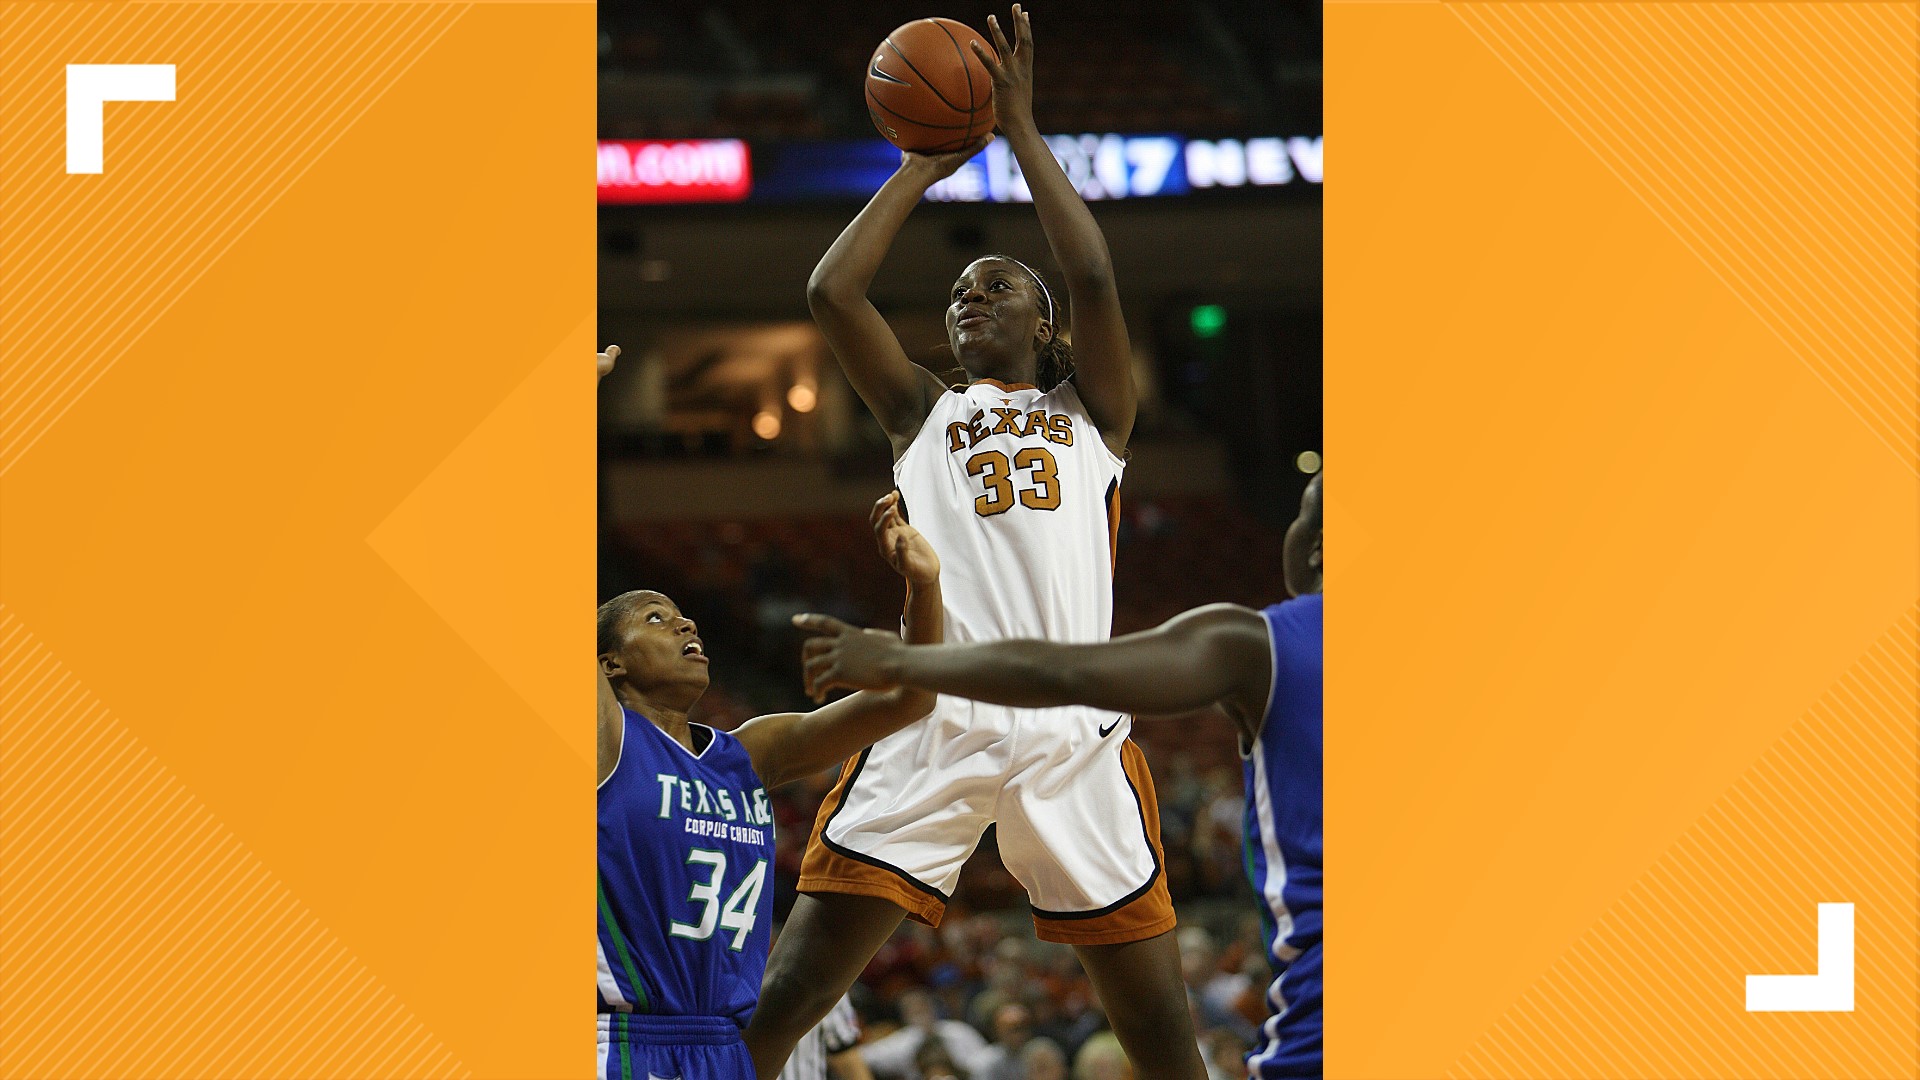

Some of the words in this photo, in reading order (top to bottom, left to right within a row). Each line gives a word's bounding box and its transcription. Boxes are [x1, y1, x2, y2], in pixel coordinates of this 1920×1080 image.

[946, 407, 1073, 454] TEXAS
[966, 447, 1061, 517] 33
[685, 817, 728, 839] CORPUS
[730, 825, 765, 846] CHRISTI
[669, 847, 768, 952] 34
